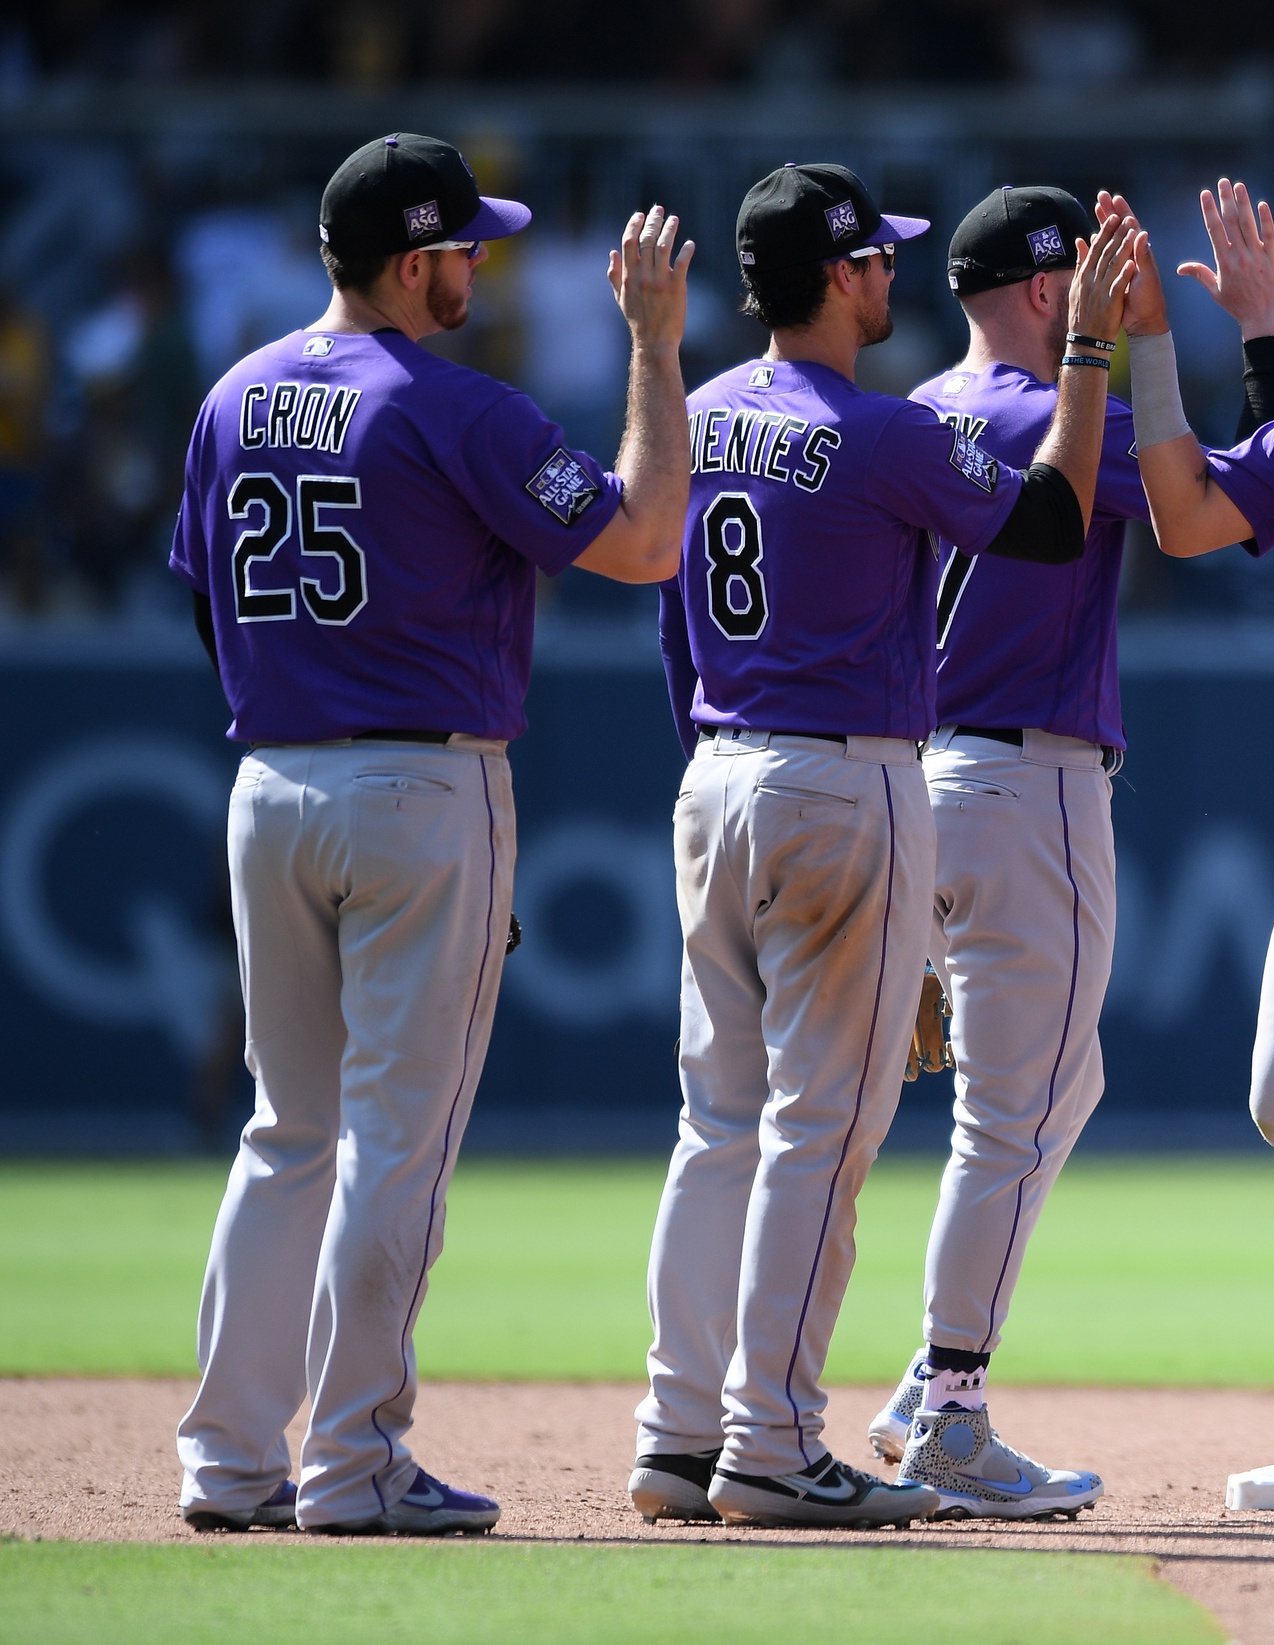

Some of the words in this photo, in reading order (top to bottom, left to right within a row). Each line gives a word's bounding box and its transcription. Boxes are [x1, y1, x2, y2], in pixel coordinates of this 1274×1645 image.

[410, 211, 438, 231] ASG
[832, 211, 855, 231] ASG
[1035, 236, 1060, 256] ASG
[240, 382, 362, 454] CRON
[688, 408, 842, 494] UENTES
[554, 474, 584, 506] GAME
[227, 472, 369, 627] 25
[702, 491, 770, 642] 8
